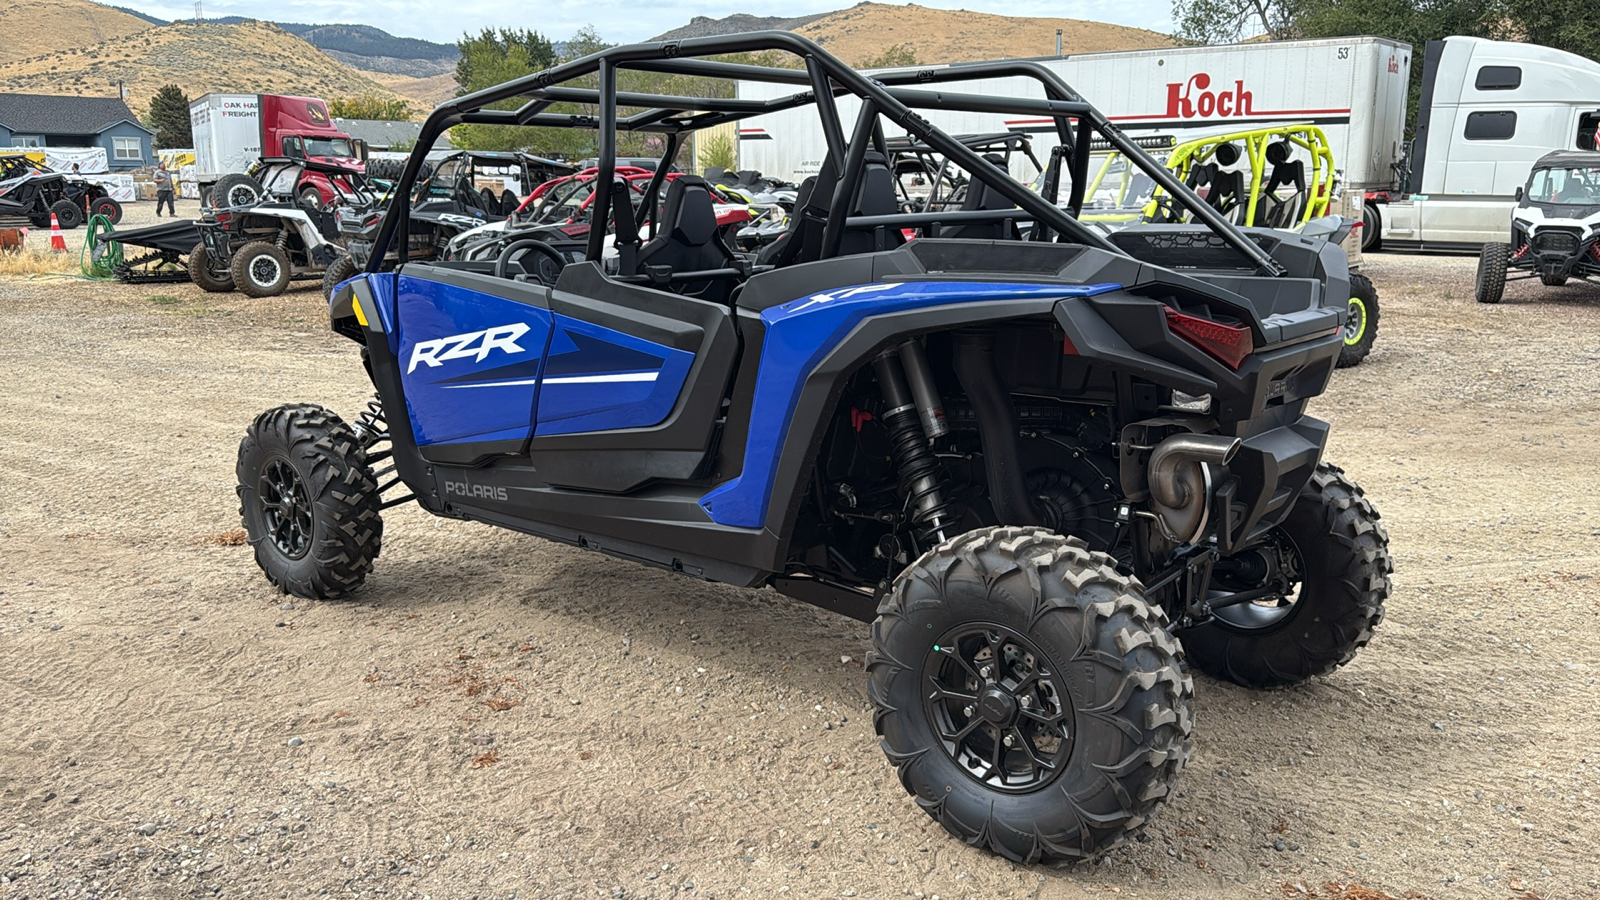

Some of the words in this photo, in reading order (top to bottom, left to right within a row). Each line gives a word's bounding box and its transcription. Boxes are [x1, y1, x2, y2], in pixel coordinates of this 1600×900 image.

[1166, 73, 1253, 118] Koch
[437, 213, 487, 227] RZR
[787, 282, 905, 313] XP
[407, 322, 531, 375] RZR
[445, 481, 508, 501] POLARIS
